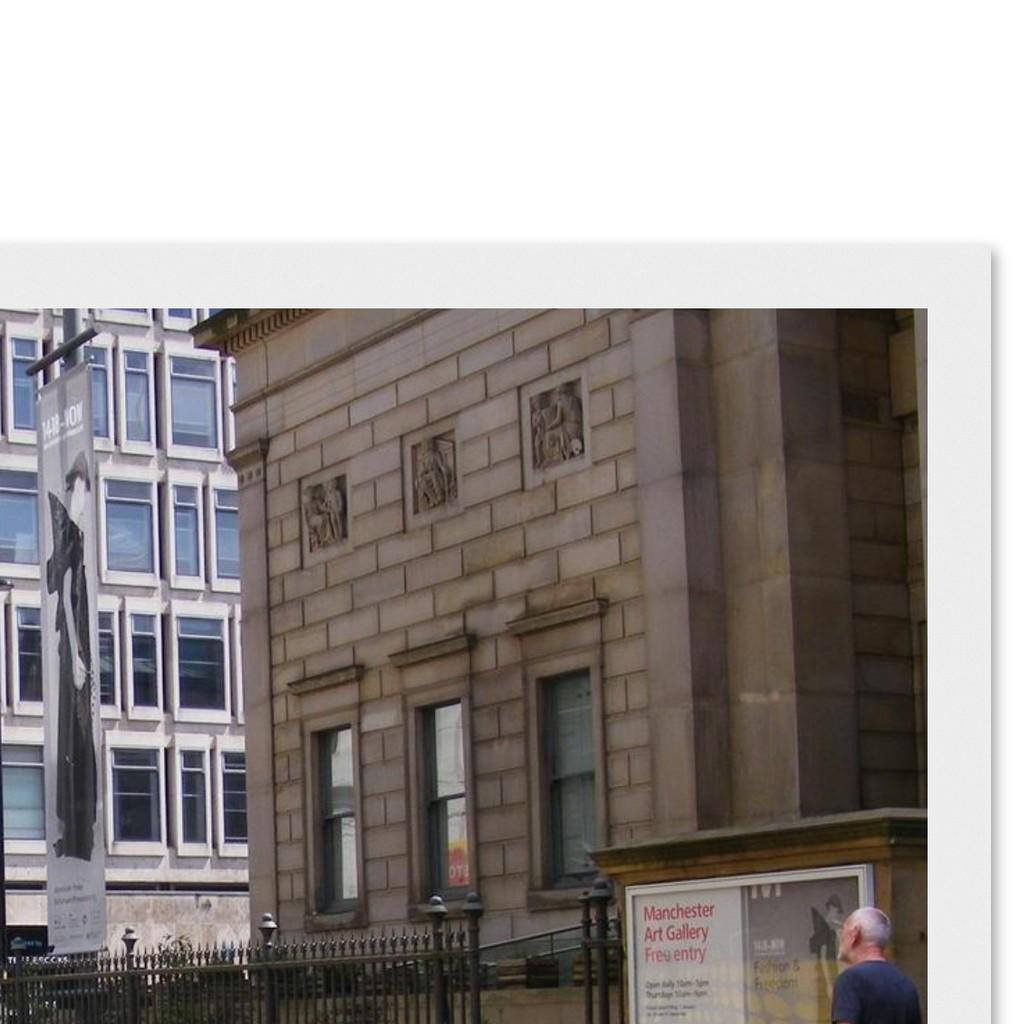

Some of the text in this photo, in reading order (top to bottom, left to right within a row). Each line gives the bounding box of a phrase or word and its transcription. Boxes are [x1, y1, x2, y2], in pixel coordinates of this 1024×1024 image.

[644, 903, 715, 921] Manchester
[645, 923, 709, 943] Art Gallery
[673, 947, 707, 964] entry
